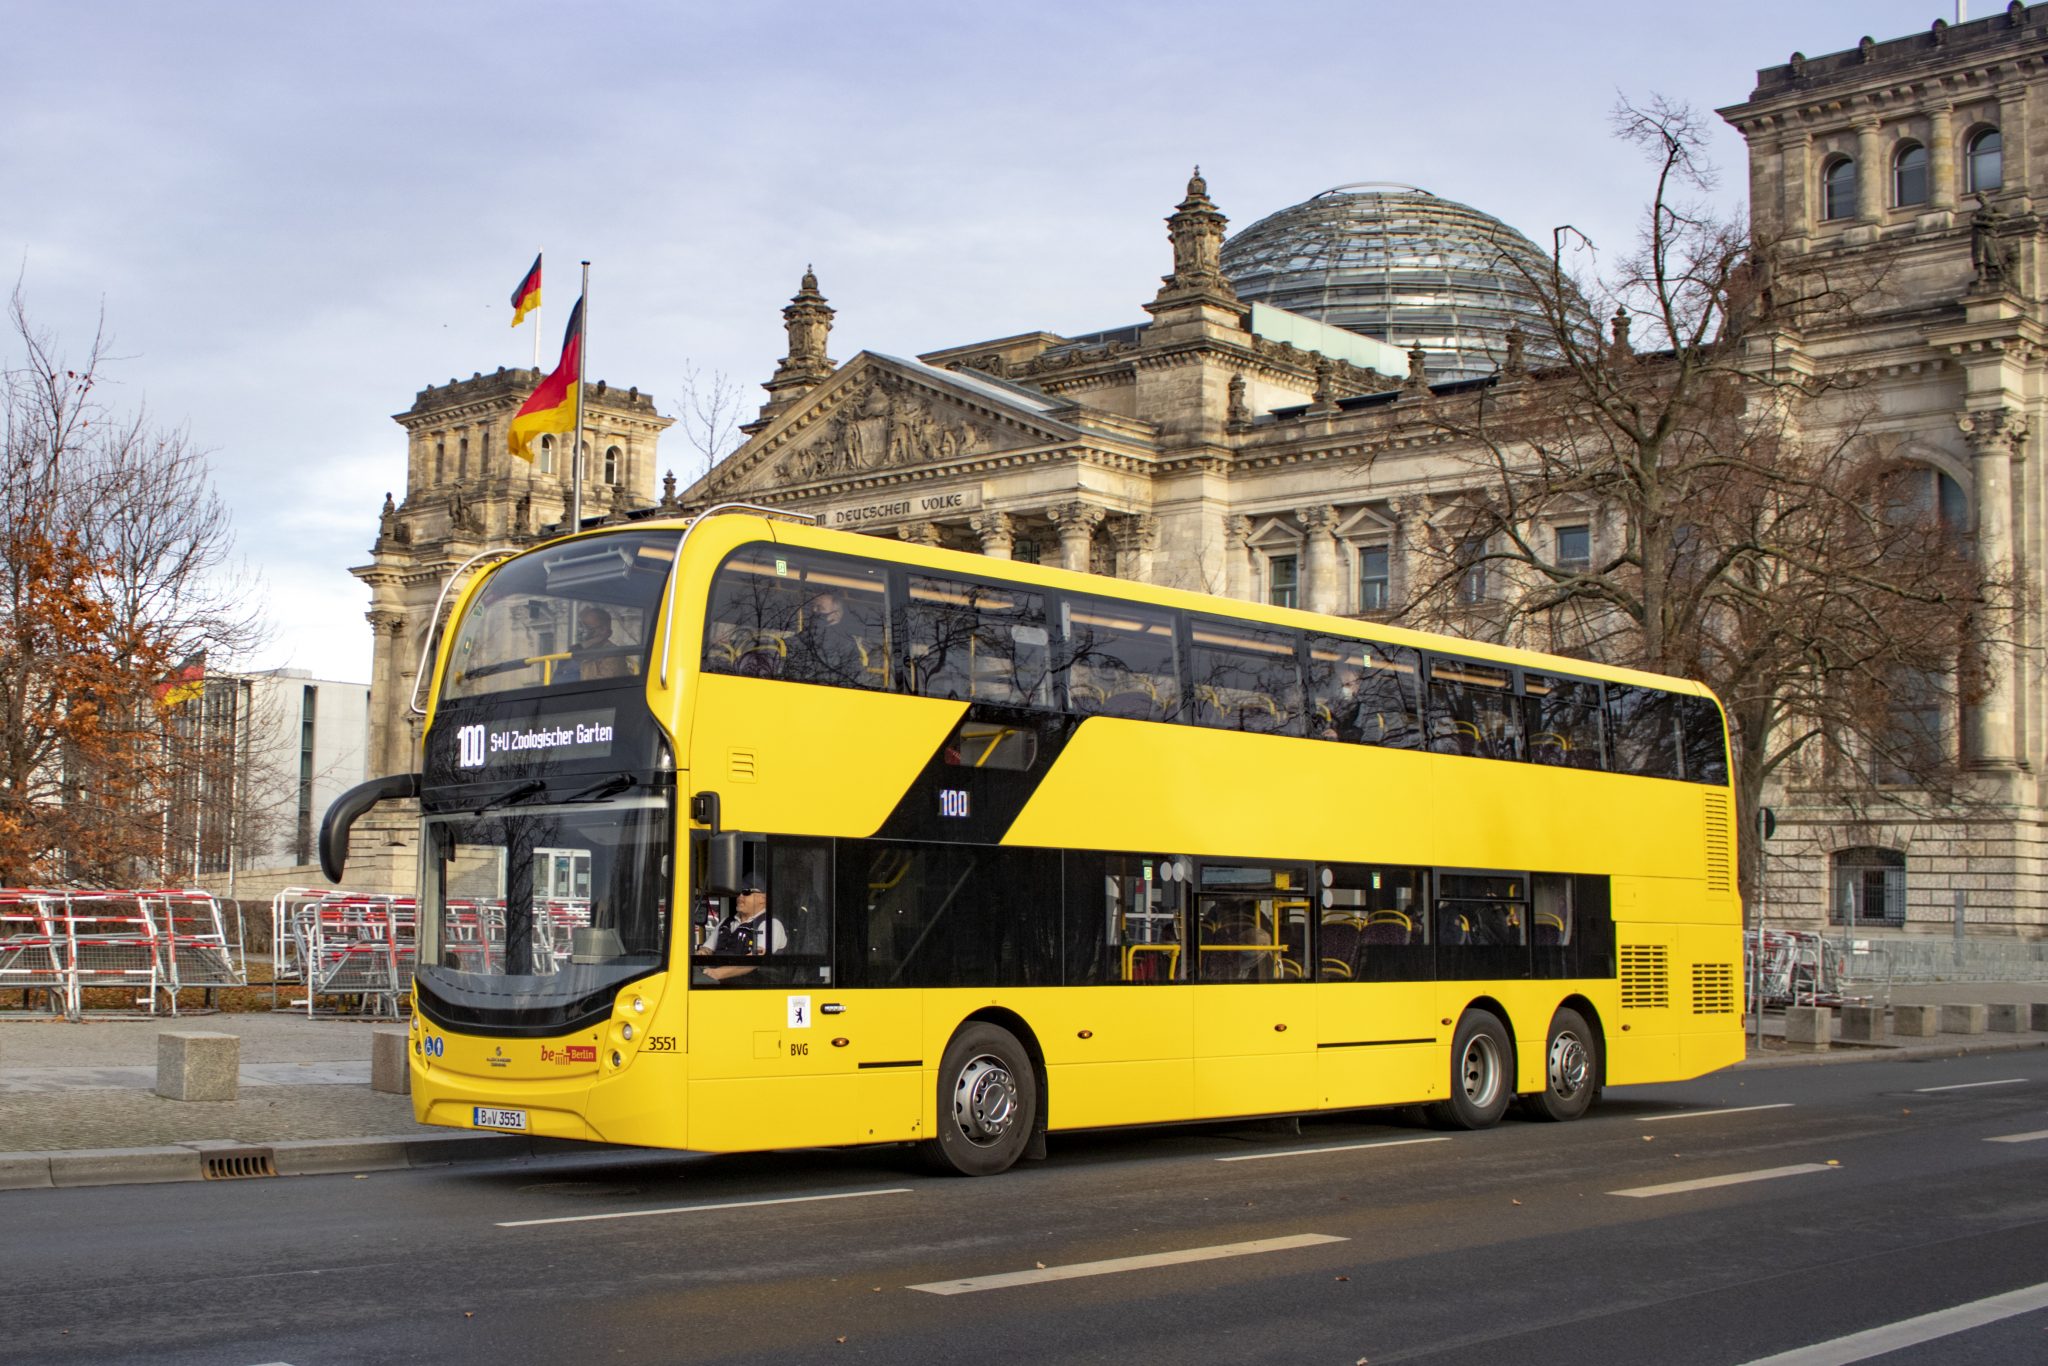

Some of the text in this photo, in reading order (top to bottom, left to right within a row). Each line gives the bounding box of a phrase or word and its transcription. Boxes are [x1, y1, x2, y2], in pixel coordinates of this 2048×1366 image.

[836, 501, 912, 524] DEUTSCHEN
[921, 494, 963, 512] VOLKE
[457, 723, 613, 768] 100 S+U Zoologischer Garten
[940, 789, 968, 817] 100
[648, 1036, 677, 1051] 3551
[790, 1043, 809, 1056] BVG
[541, 1045, 594, 1061] be Berlin
[499, 1111, 522, 1127] 3551
